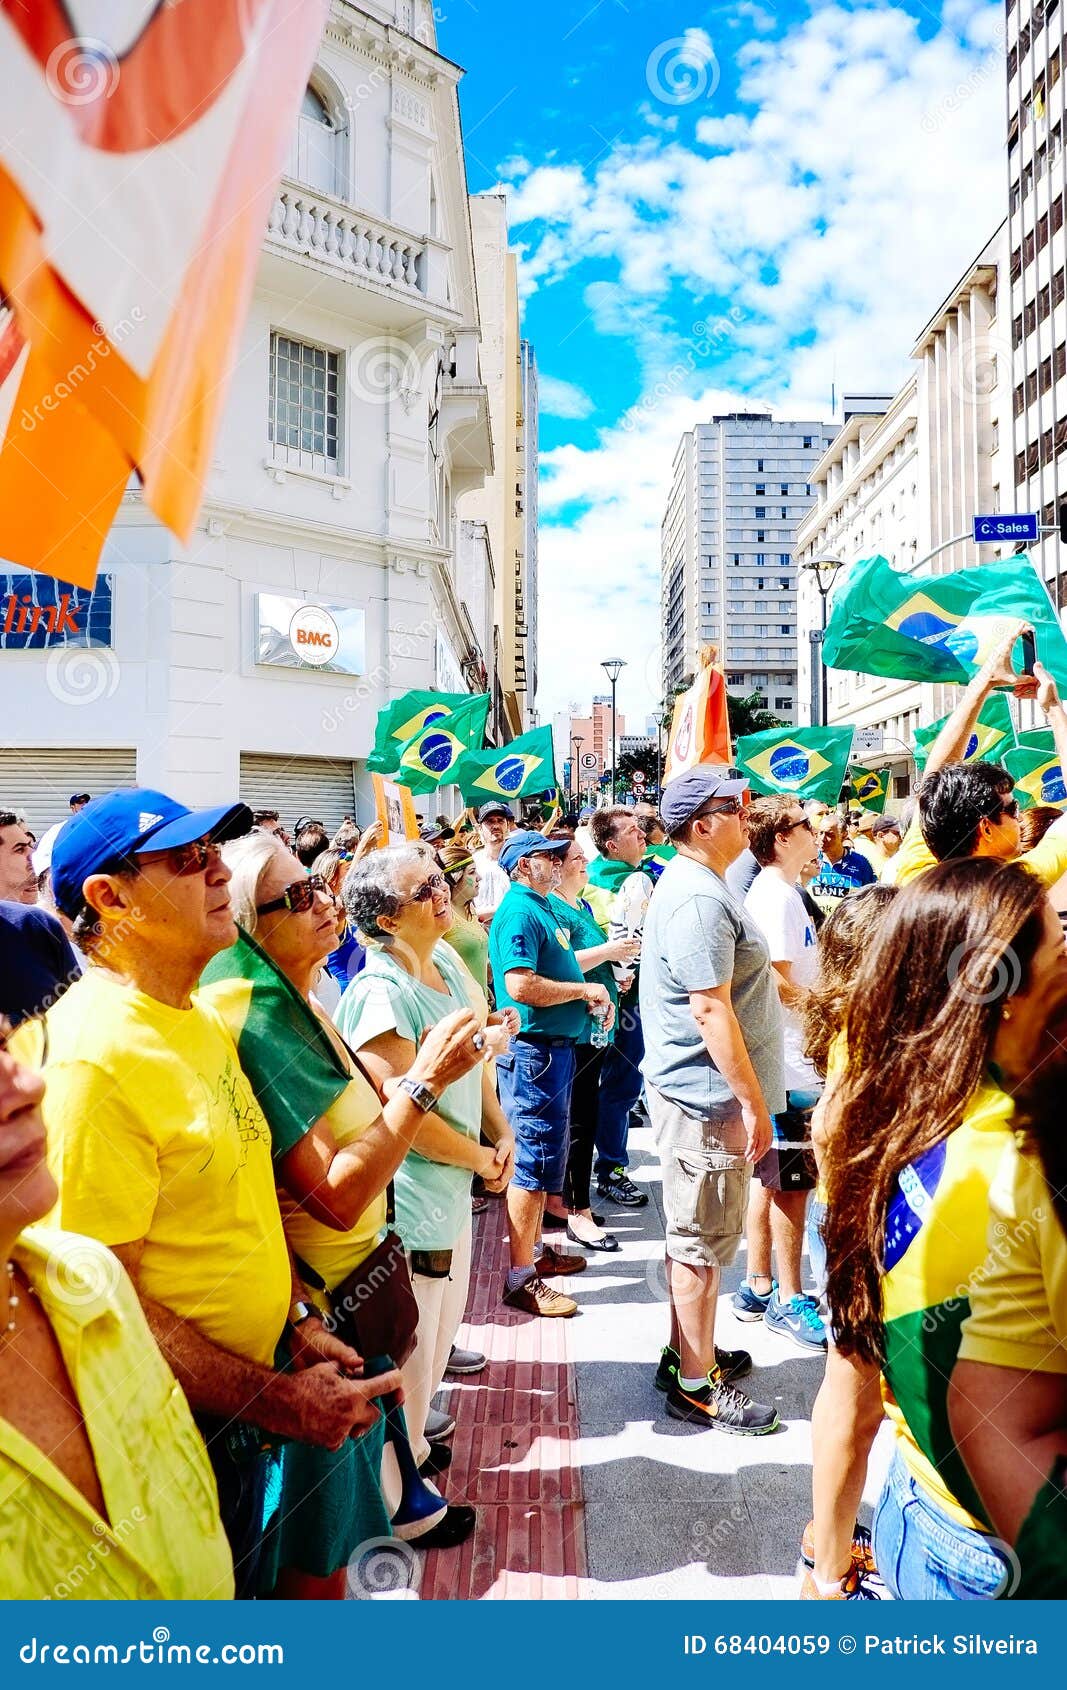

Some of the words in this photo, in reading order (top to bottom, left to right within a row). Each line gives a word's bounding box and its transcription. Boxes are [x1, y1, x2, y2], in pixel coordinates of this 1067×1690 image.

[981, 524, 994, 534] C.
[996, 523, 1029, 534] Sales
[3, 594, 82, 633] link
[296, 629, 332, 647] BMG
[585, 756, 592, 765] E
[814, 887, 846, 897] BANK
